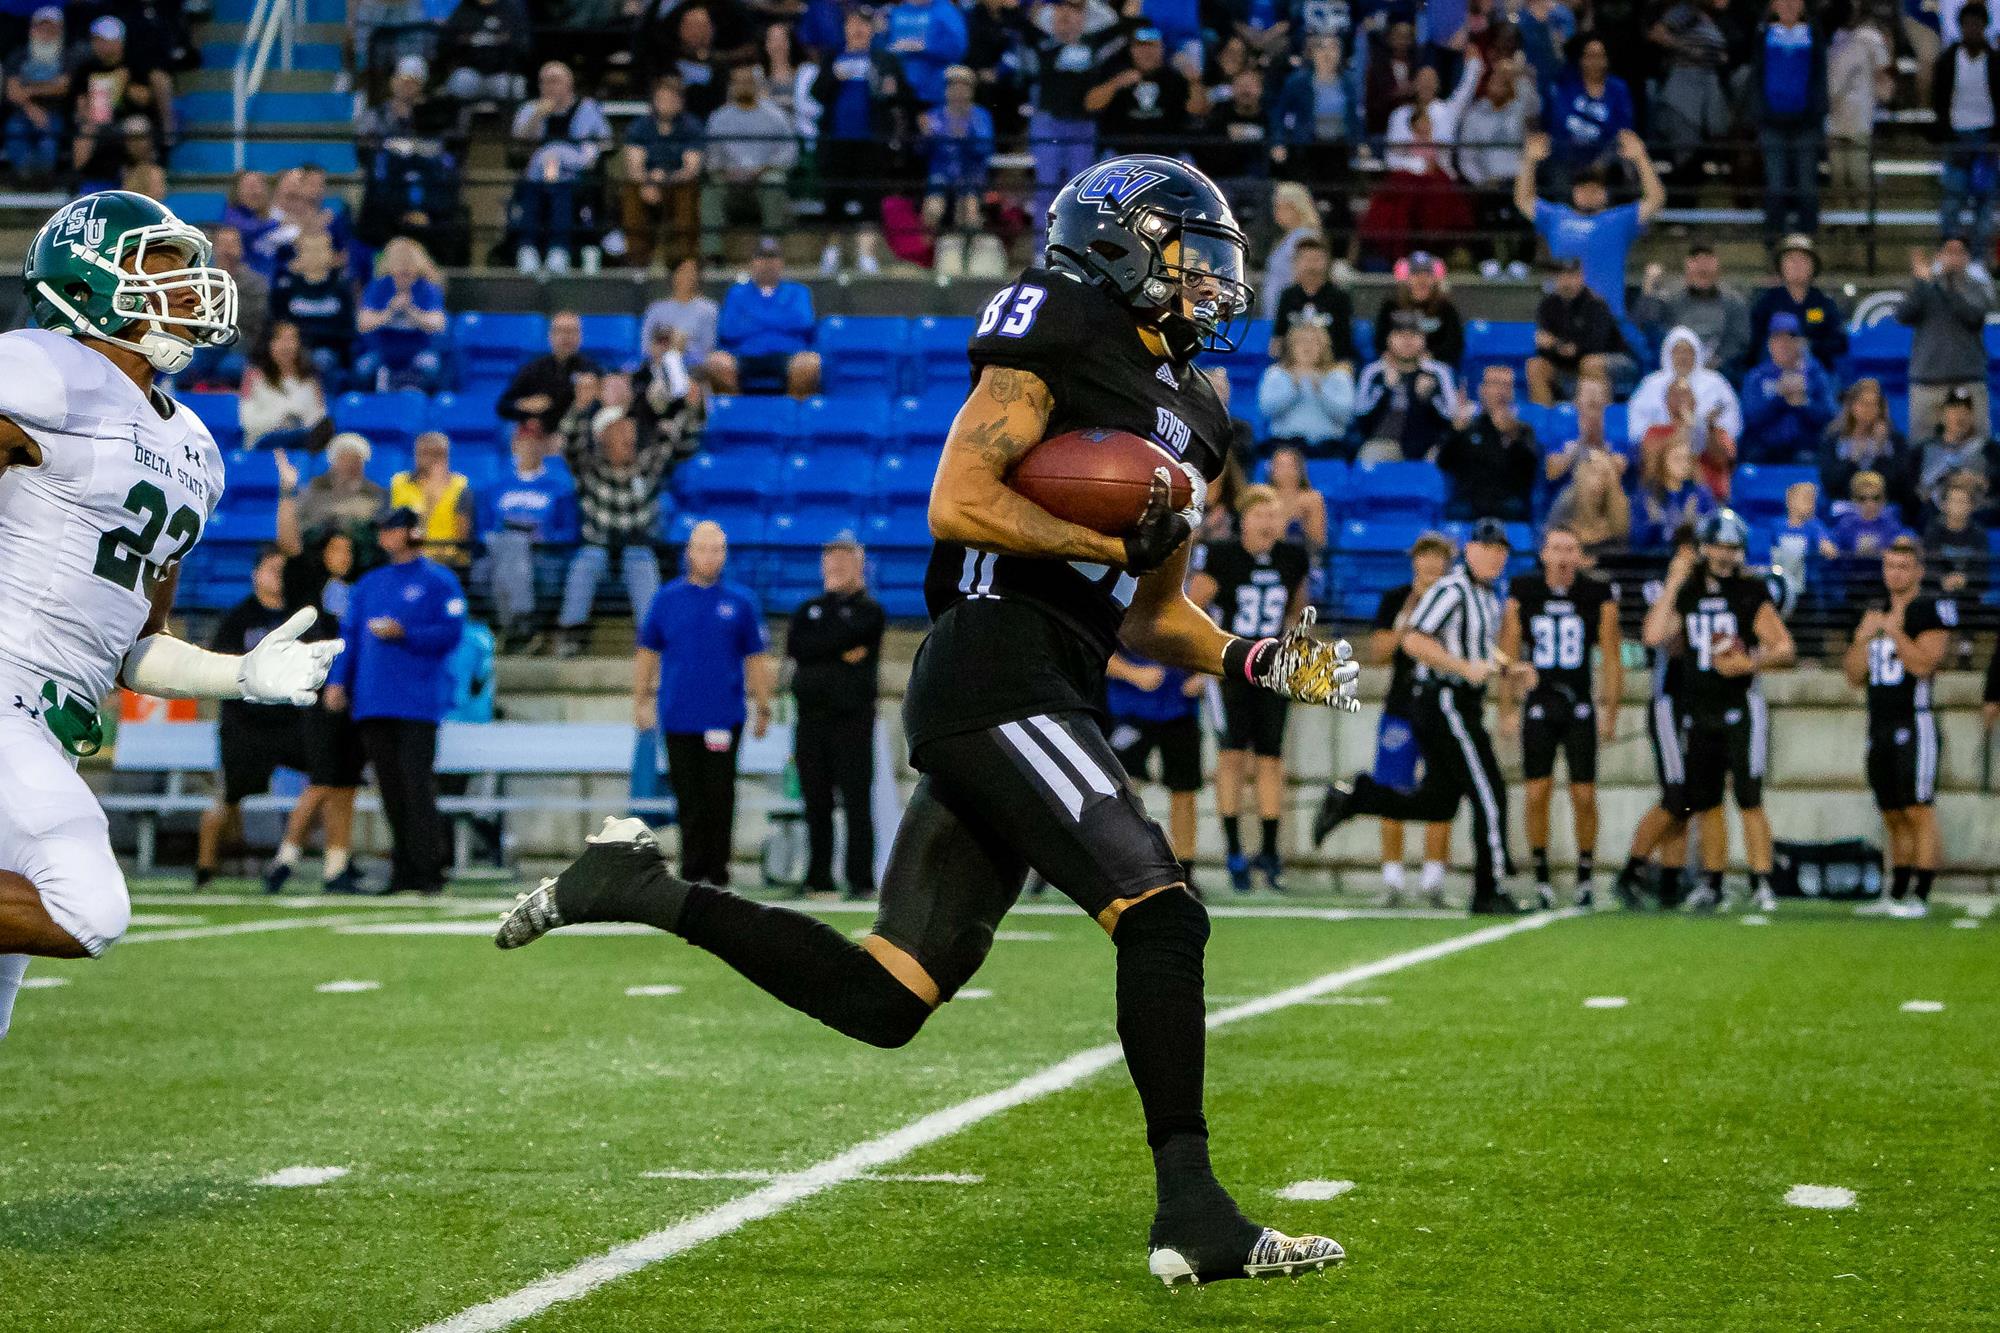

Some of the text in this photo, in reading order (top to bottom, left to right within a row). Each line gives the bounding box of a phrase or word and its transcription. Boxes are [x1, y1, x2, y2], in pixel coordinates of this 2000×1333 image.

[976, 284, 1048, 338] 83
[1156, 406, 1192, 455] GVSU
[135, 445, 204, 500] DELTA STATE
[1530, 613, 1585, 669] 38
